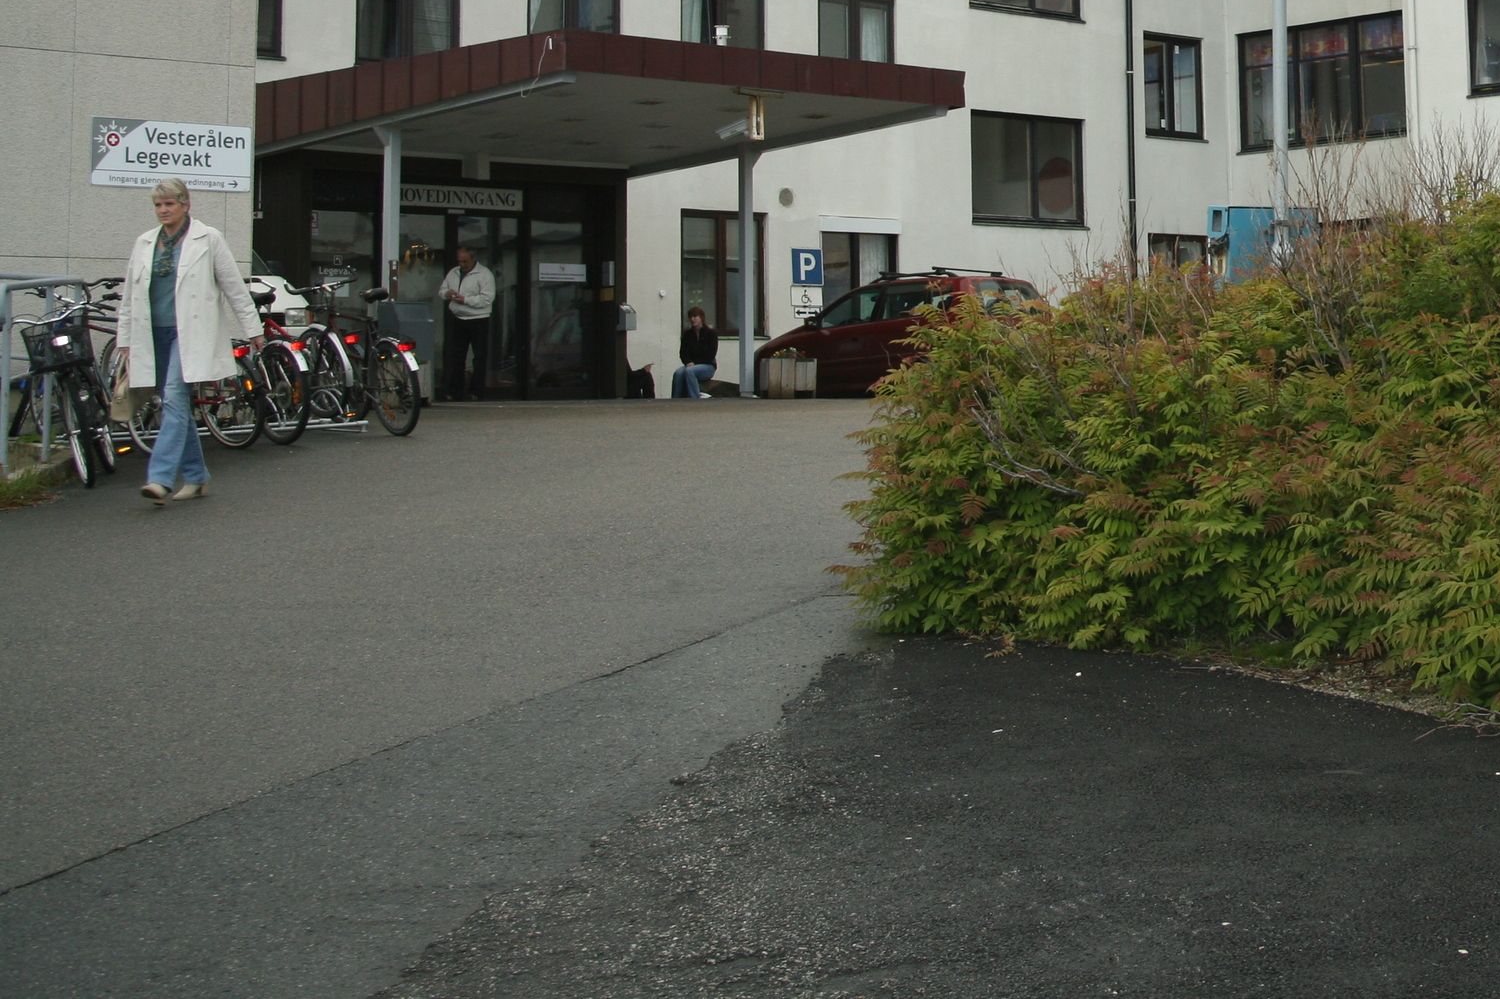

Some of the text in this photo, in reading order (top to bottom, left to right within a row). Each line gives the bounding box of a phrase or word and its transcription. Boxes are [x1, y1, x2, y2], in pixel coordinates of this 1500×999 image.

[145, 127, 246, 150] Vesterålen
[125, 146, 212, 169] Legevakt
[319, 266, 356, 276] Legeva
[800, 252, 816, 281] P
